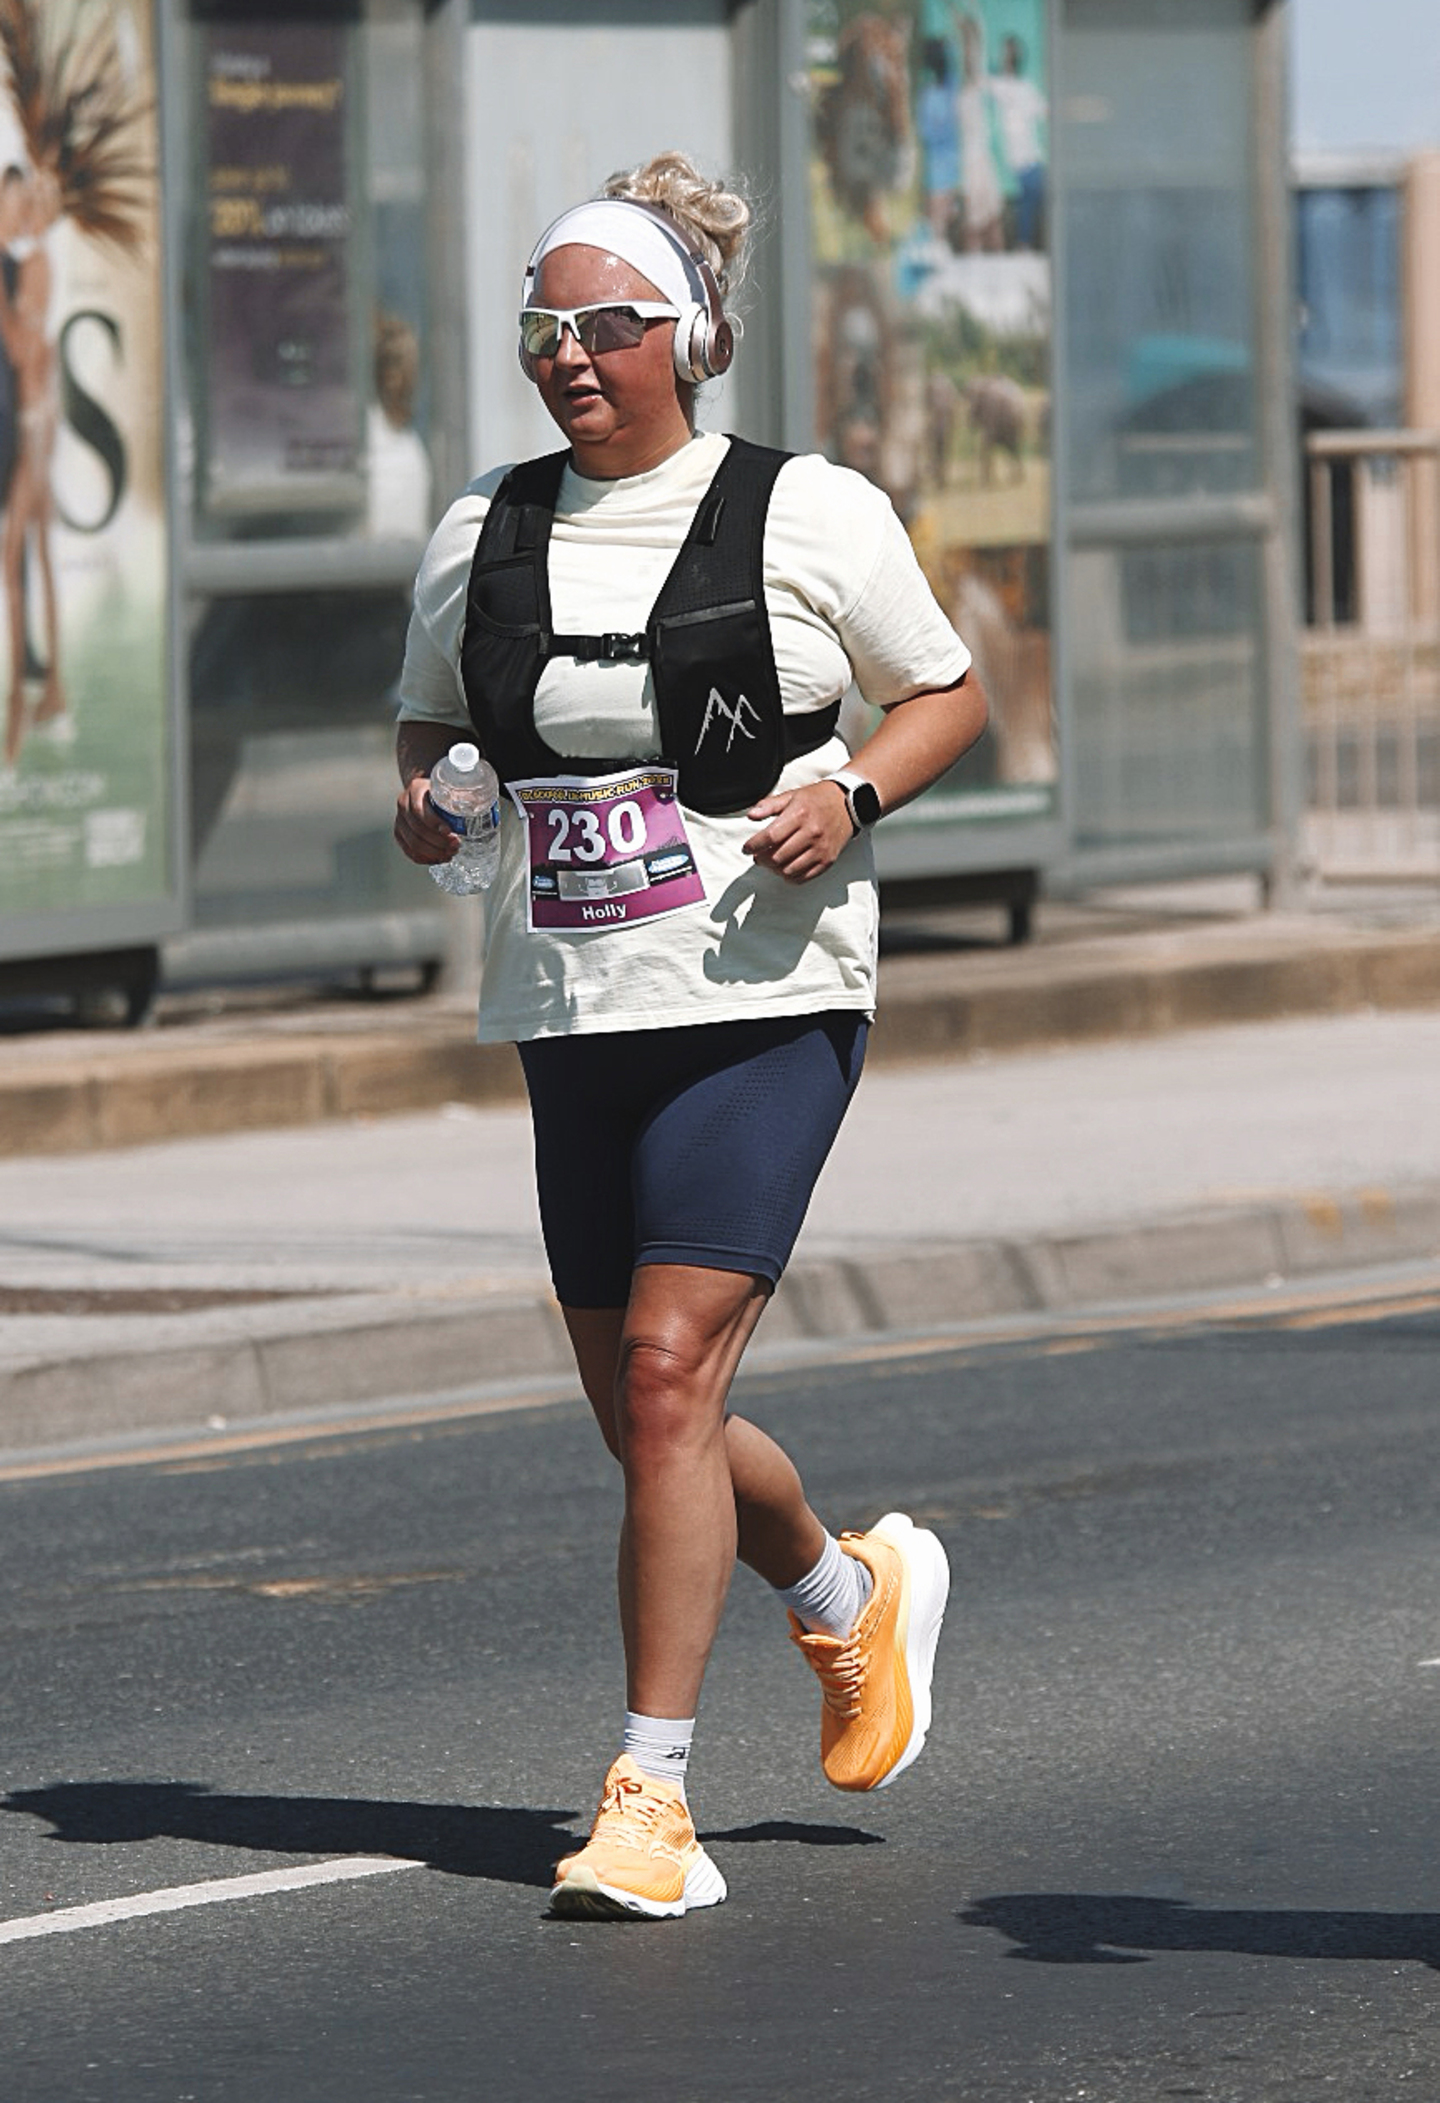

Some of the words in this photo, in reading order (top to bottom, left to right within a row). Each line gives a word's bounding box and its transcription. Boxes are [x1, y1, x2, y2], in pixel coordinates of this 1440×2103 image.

[59, 309, 127, 534] S
[581, 786, 614, 800] MUSIC
[615, 780, 640, 796] RUN
[548, 801, 647, 861] 230
[582, 904, 626, 920] Holly
